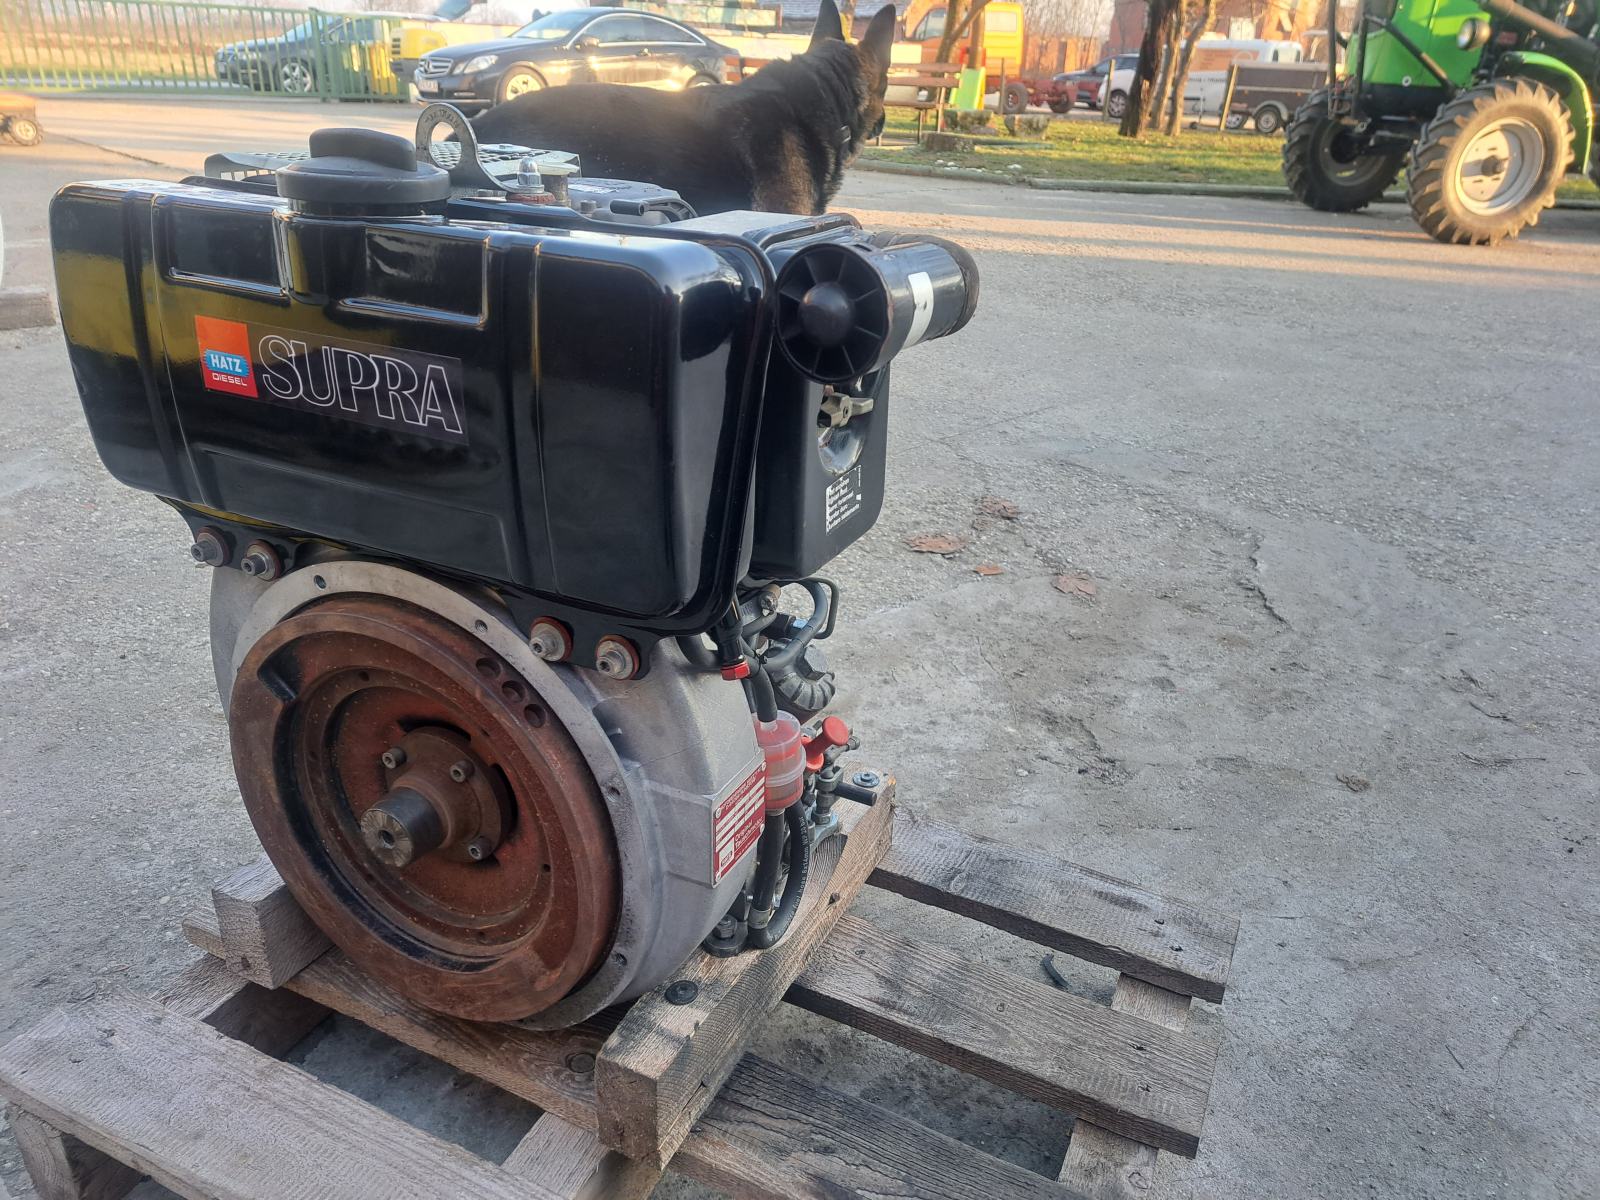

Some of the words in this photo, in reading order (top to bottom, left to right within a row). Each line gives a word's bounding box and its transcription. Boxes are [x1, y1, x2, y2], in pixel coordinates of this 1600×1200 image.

[210, 353, 243, 374] HATZ
[212, 372, 248, 386] DIESEL
[258, 334, 463, 435] SUPRA
